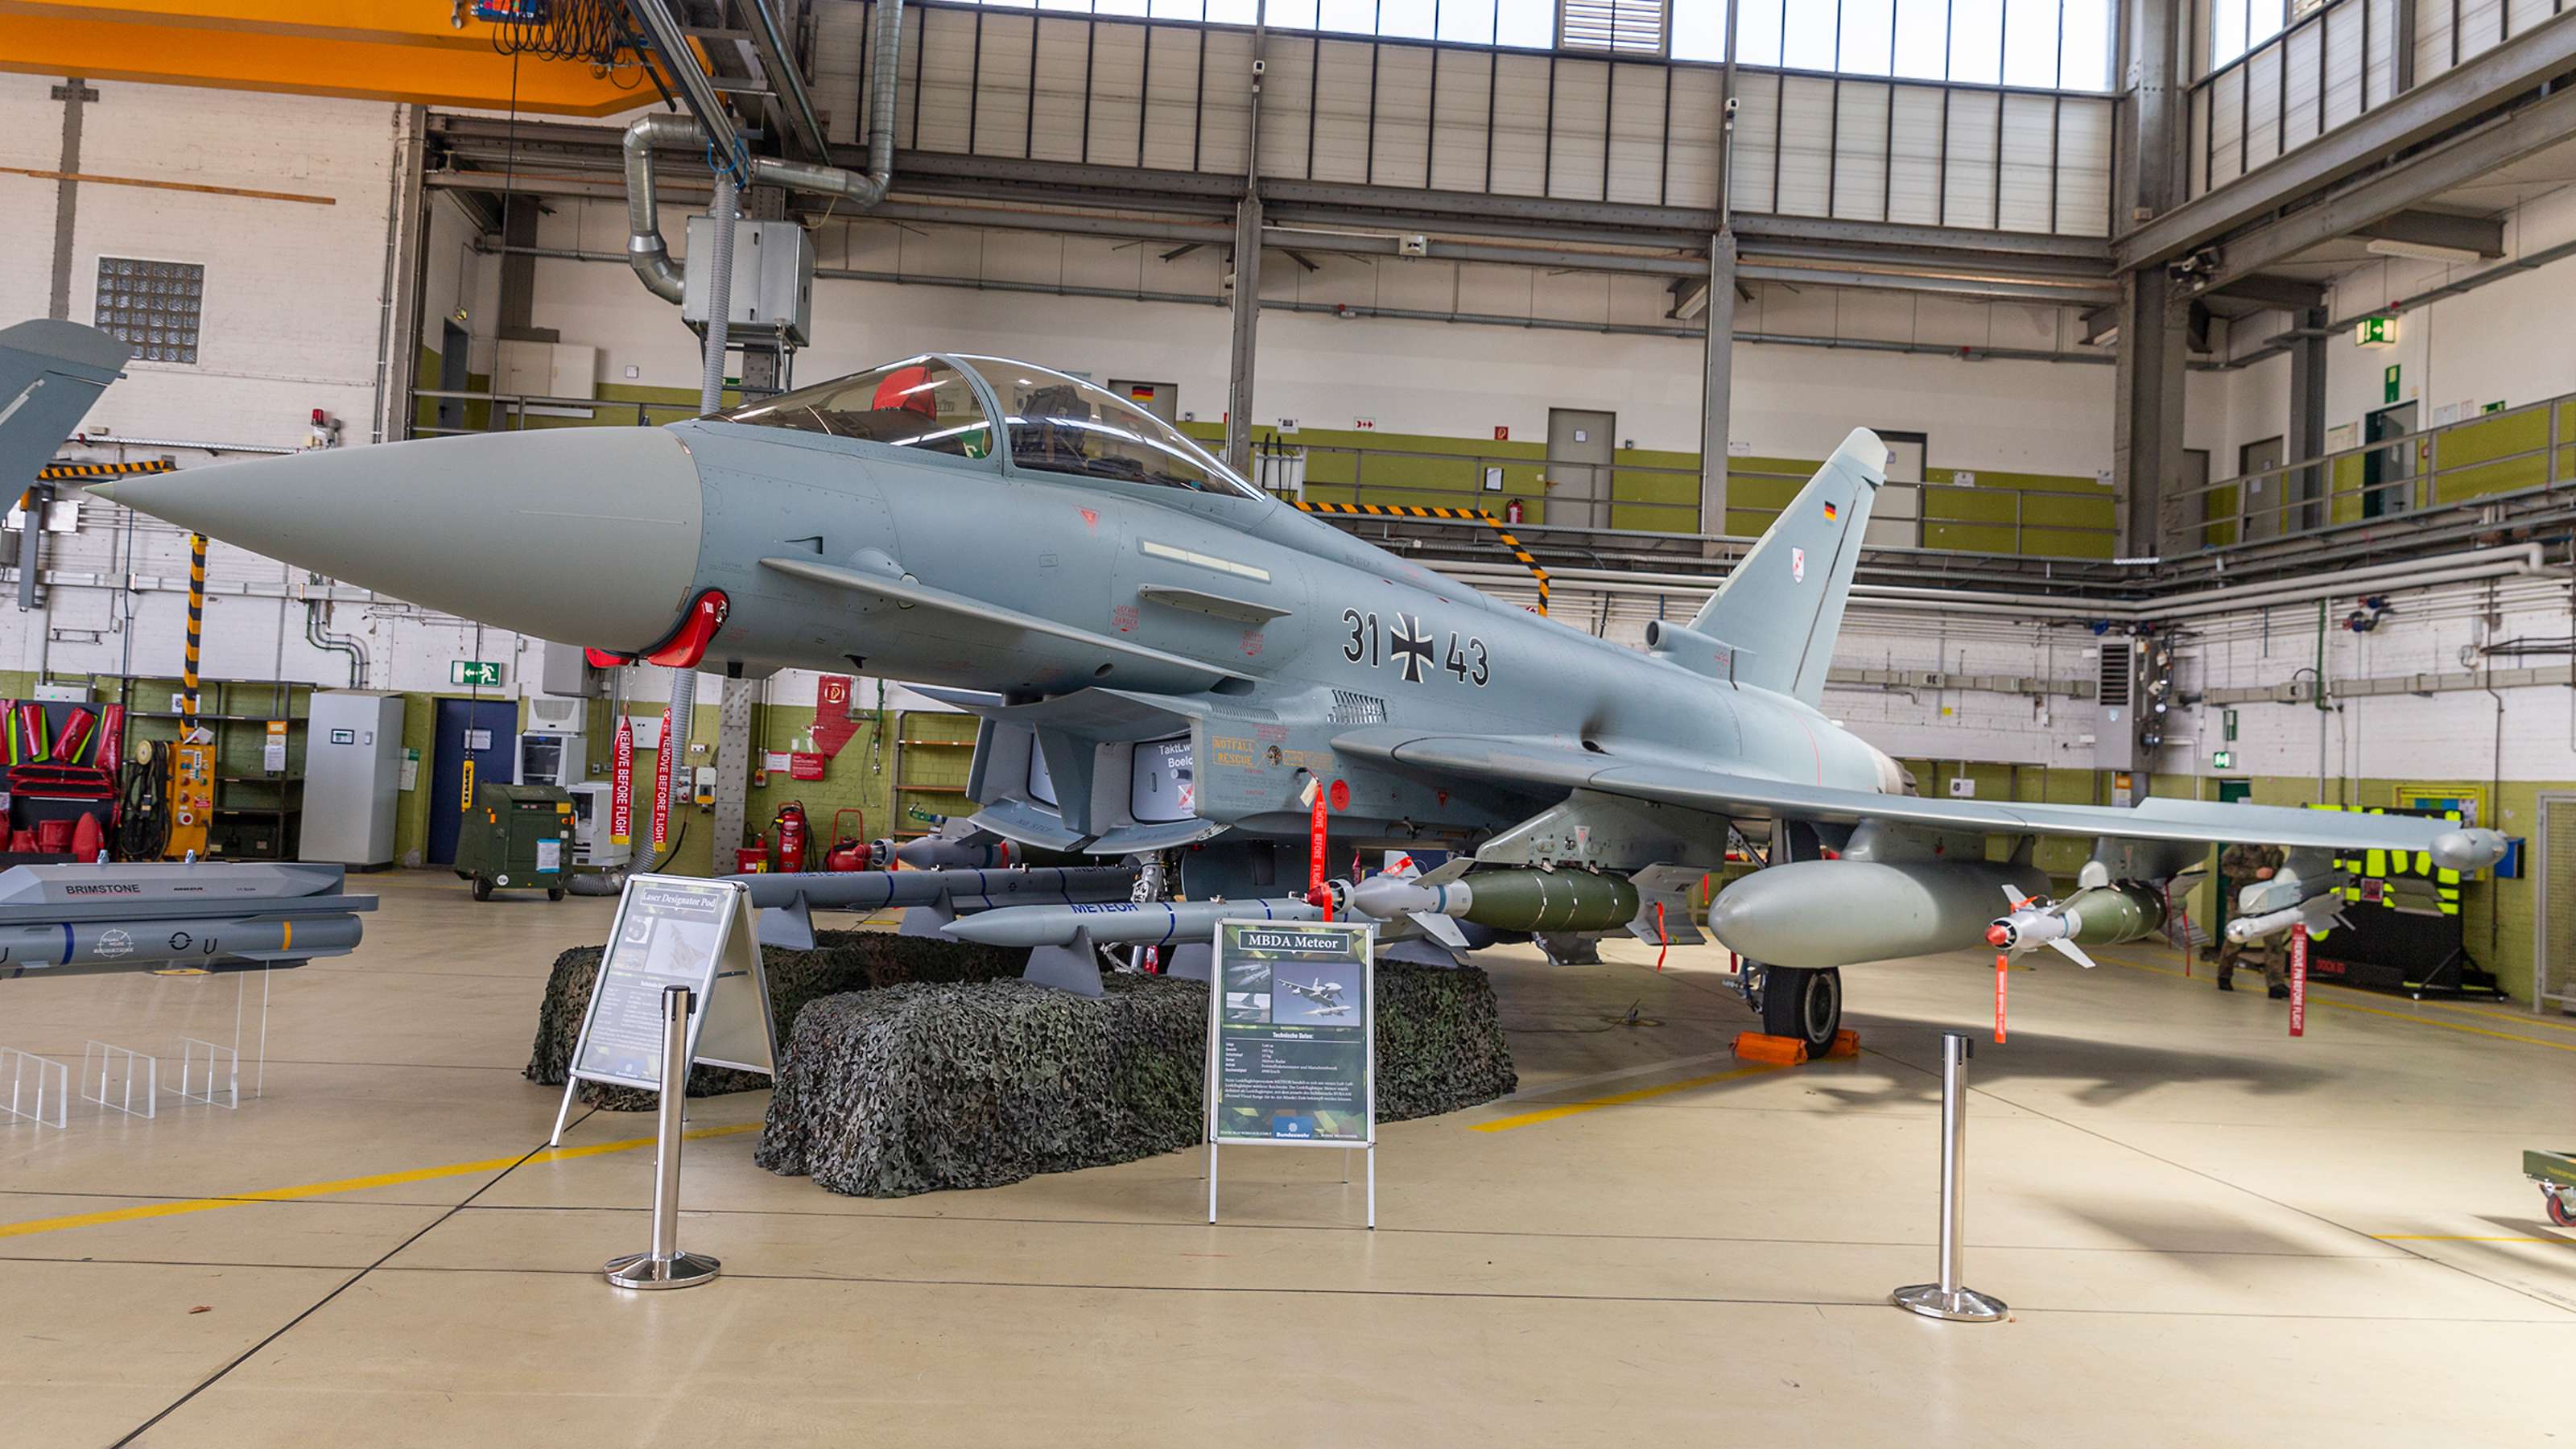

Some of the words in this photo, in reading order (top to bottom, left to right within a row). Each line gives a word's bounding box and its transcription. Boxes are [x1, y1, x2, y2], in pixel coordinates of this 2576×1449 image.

[1343, 608, 1379, 667] 31
[1445, 631, 1491, 687] 43
[617, 730, 631, 767] REMOVE
[659, 735, 672, 774] REMOVE
[1159, 743, 1191, 755] TaktLw
[1215, 739, 1253, 753] NOTFALL
[1217, 752, 1253, 766] RESCUE
[616, 769, 630, 805] BEFORE
[657, 775, 668, 811] BEFORE
[614, 806, 628, 836] FLIGHT
[654, 812, 666, 843] FLIGHT
[1315, 801, 1323, 828] REMOVE
[1313, 832, 1323, 860] BEFORE
[66, 883, 141, 894] BRIMSTONE
[1311, 864, 1321, 889] FLIGH
[644, 892, 662, 901] Laser
[662, 894, 700, 906] Designator
[701, 898, 716, 907] Pod
[1249, 934, 1292, 948] MBDA
[1294, 935, 1339, 949] Meteor
[1273, 1031, 1298, 1039] Technische
